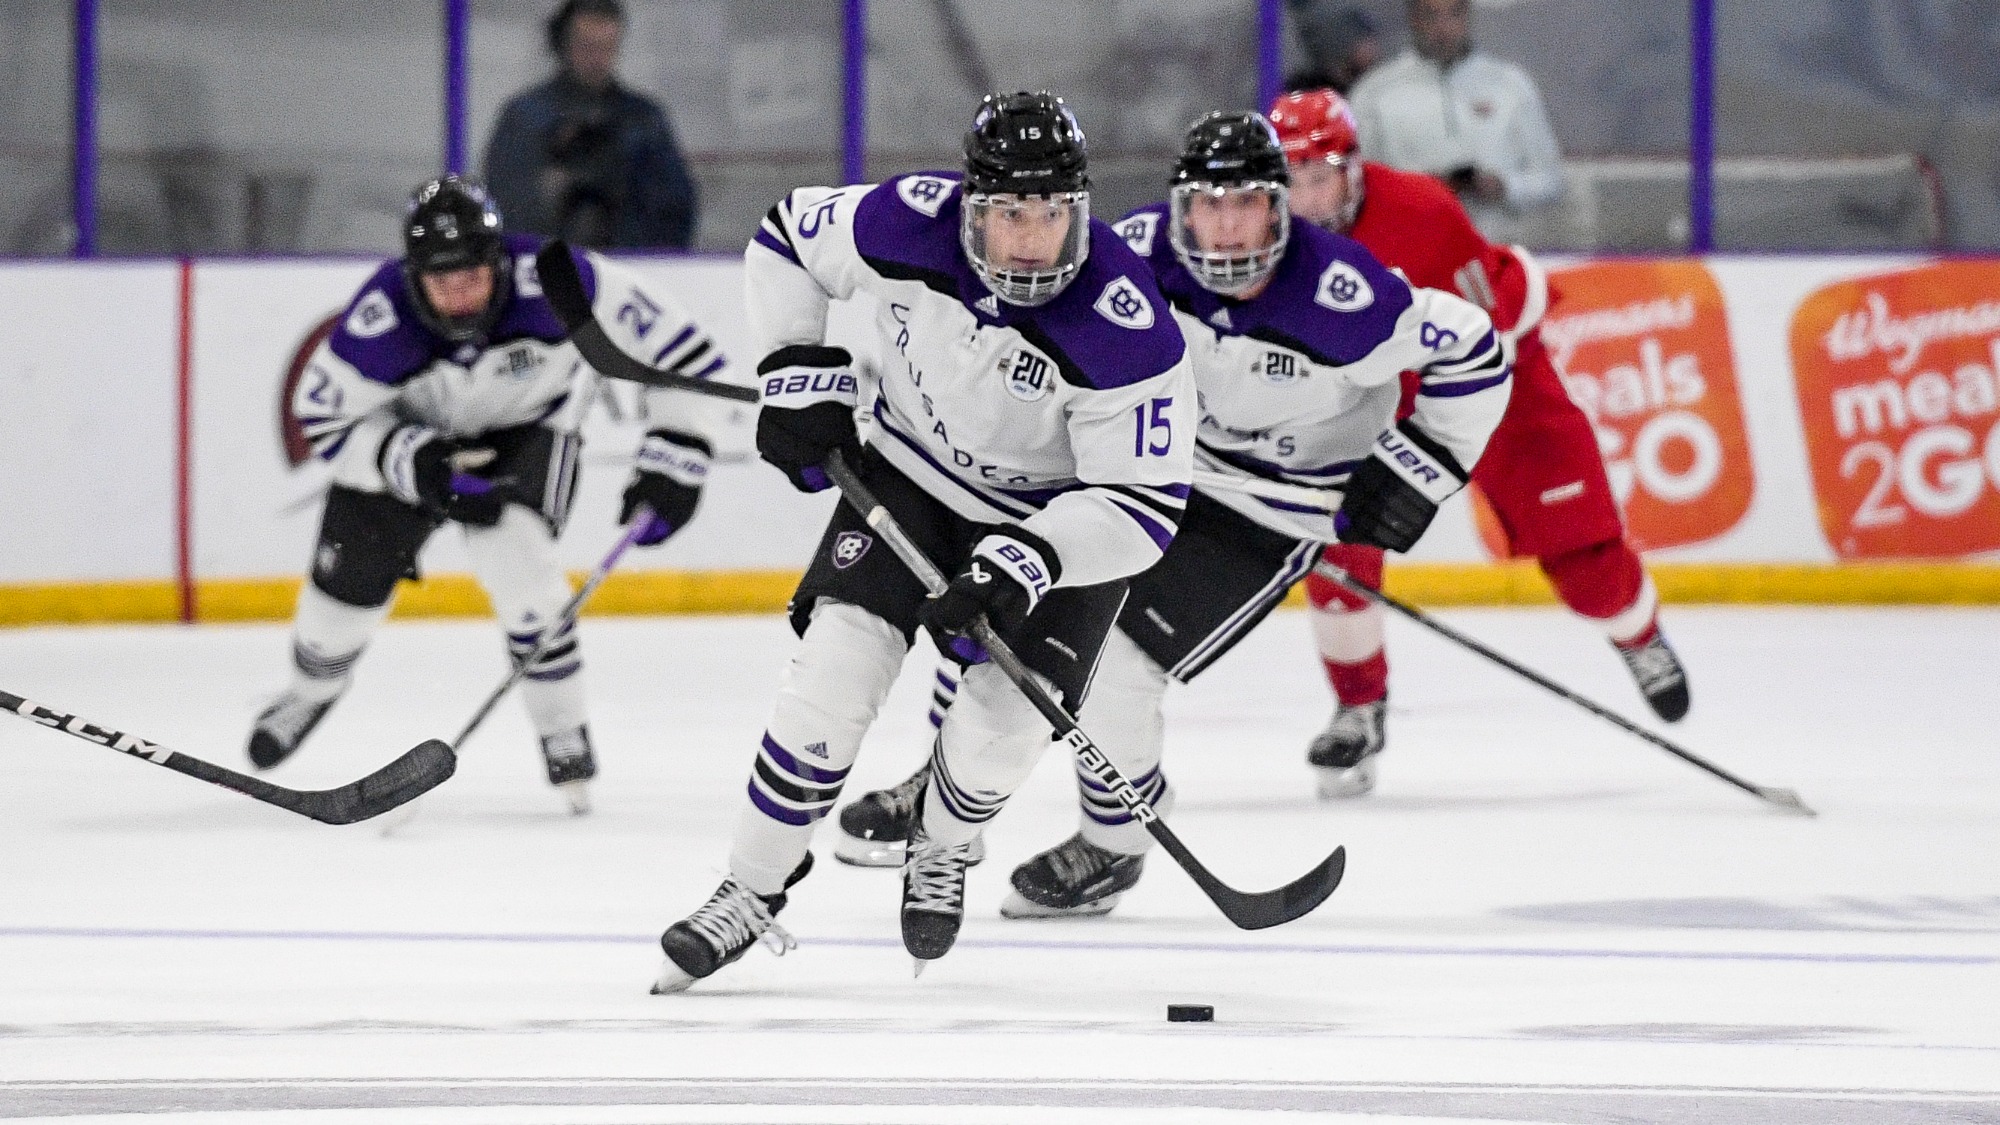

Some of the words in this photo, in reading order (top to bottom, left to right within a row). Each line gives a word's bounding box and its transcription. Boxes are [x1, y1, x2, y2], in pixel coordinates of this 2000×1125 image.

[1019, 126, 1041, 140] 15
[616, 284, 664, 340] 21
[1419, 320, 1459, 351] 8
[1012, 350, 1048, 391] 20
[1266, 351, 1294, 378] 20
[1133, 397, 1174, 458] 15
[16, 699, 175, 765] CCM
